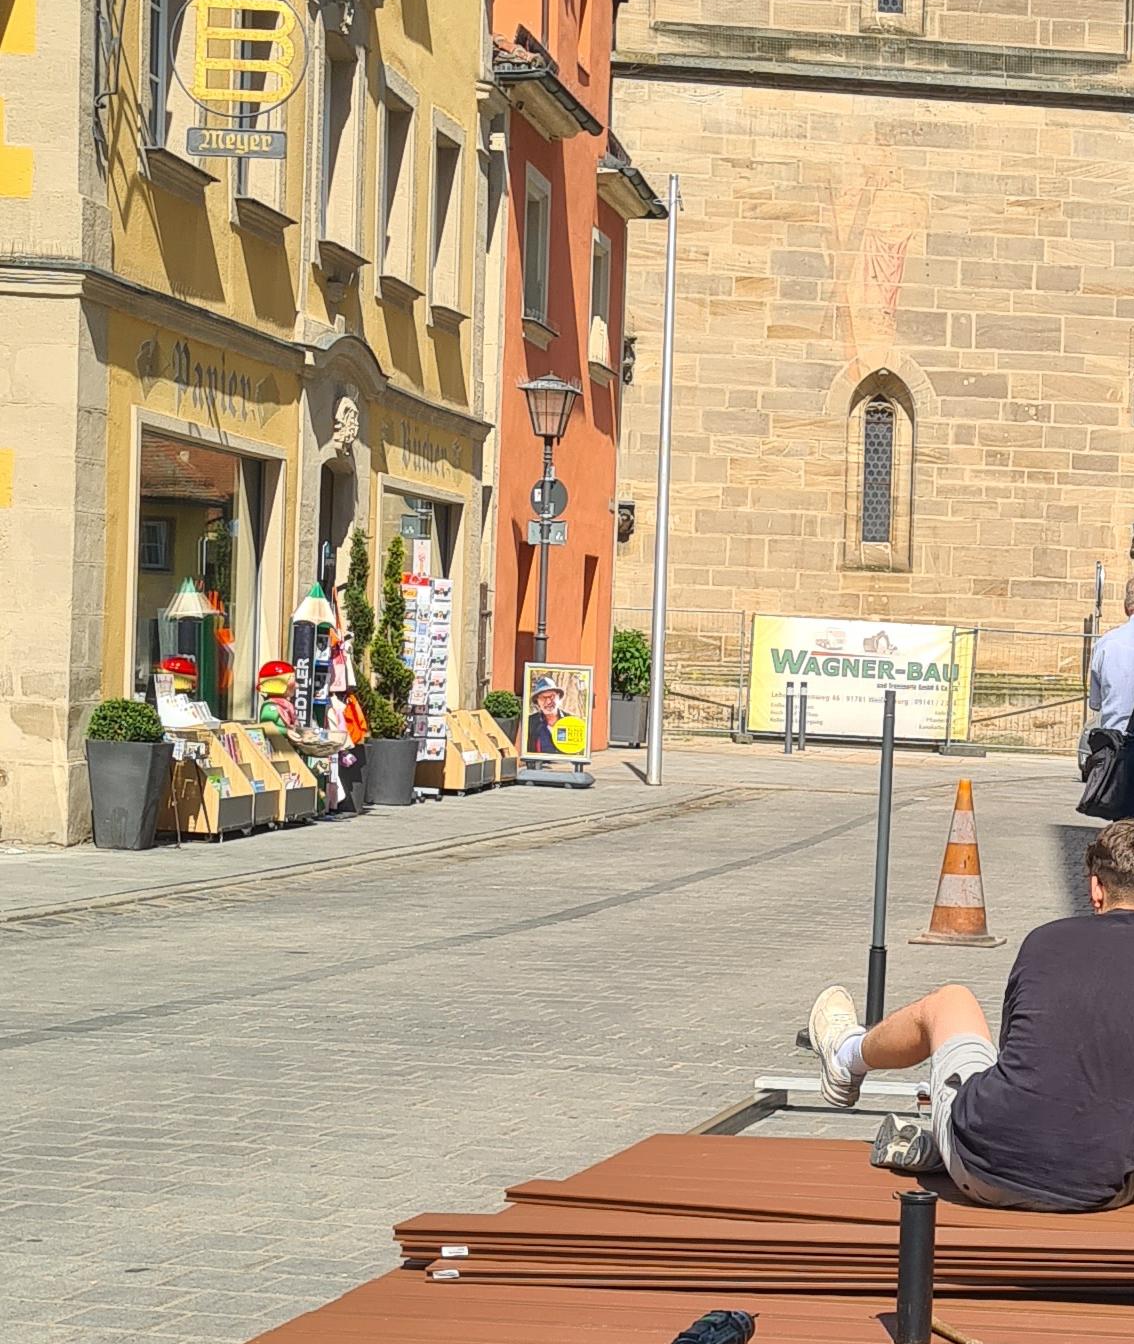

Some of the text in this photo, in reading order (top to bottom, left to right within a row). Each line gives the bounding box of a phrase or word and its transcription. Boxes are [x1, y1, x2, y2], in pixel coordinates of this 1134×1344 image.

[198, 131, 272, 154] Meyer
[172, 339, 251, 423] Papier
[771, 648, 960, 683] WAGNER-BAU
[295, 657, 310, 728] EDTLER
